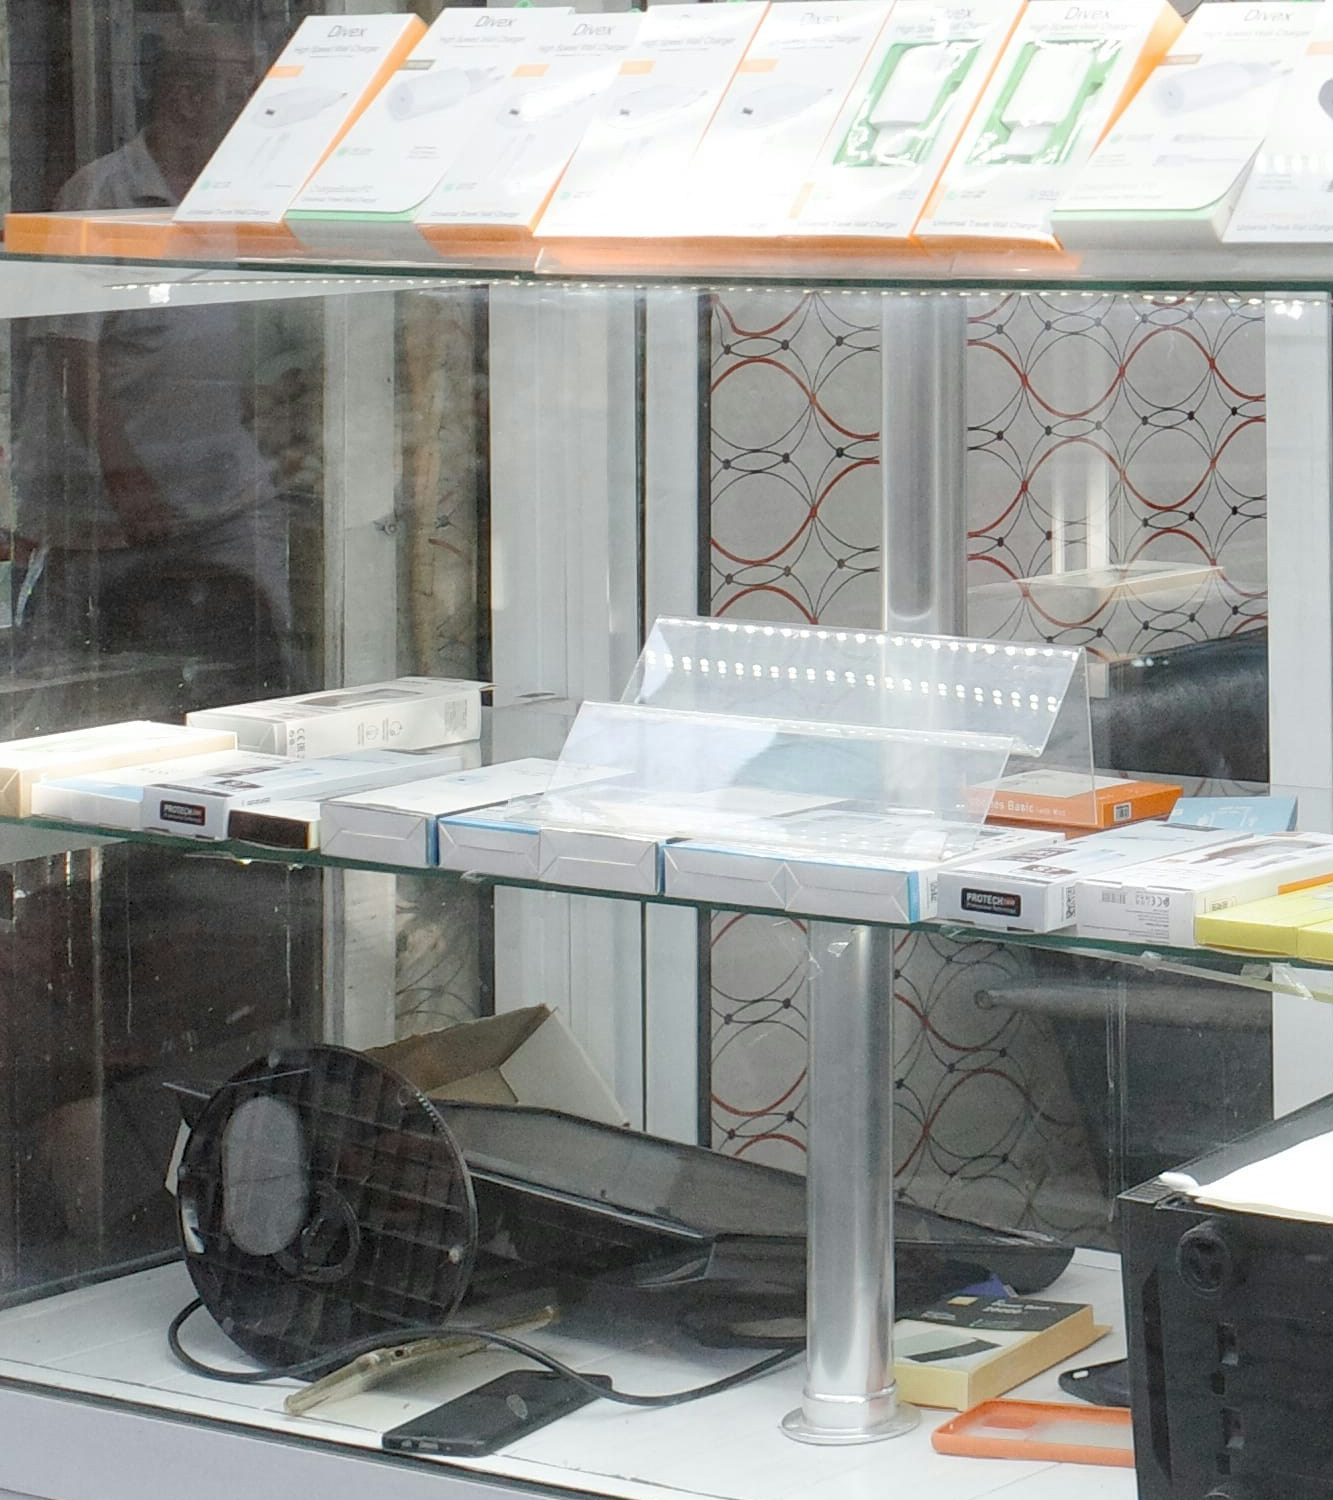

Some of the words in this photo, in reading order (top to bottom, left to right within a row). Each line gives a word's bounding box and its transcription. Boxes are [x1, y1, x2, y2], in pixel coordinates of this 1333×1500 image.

[1064, 6, 1113, 21] Divex
[1243, 8, 1296, 24] Divex
[474, 15, 518, 29] Divex
[326, 24, 369, 39] Divex
[572, 23, 616, 37] Divex
[1007, 800, 1035, 813] Basic
